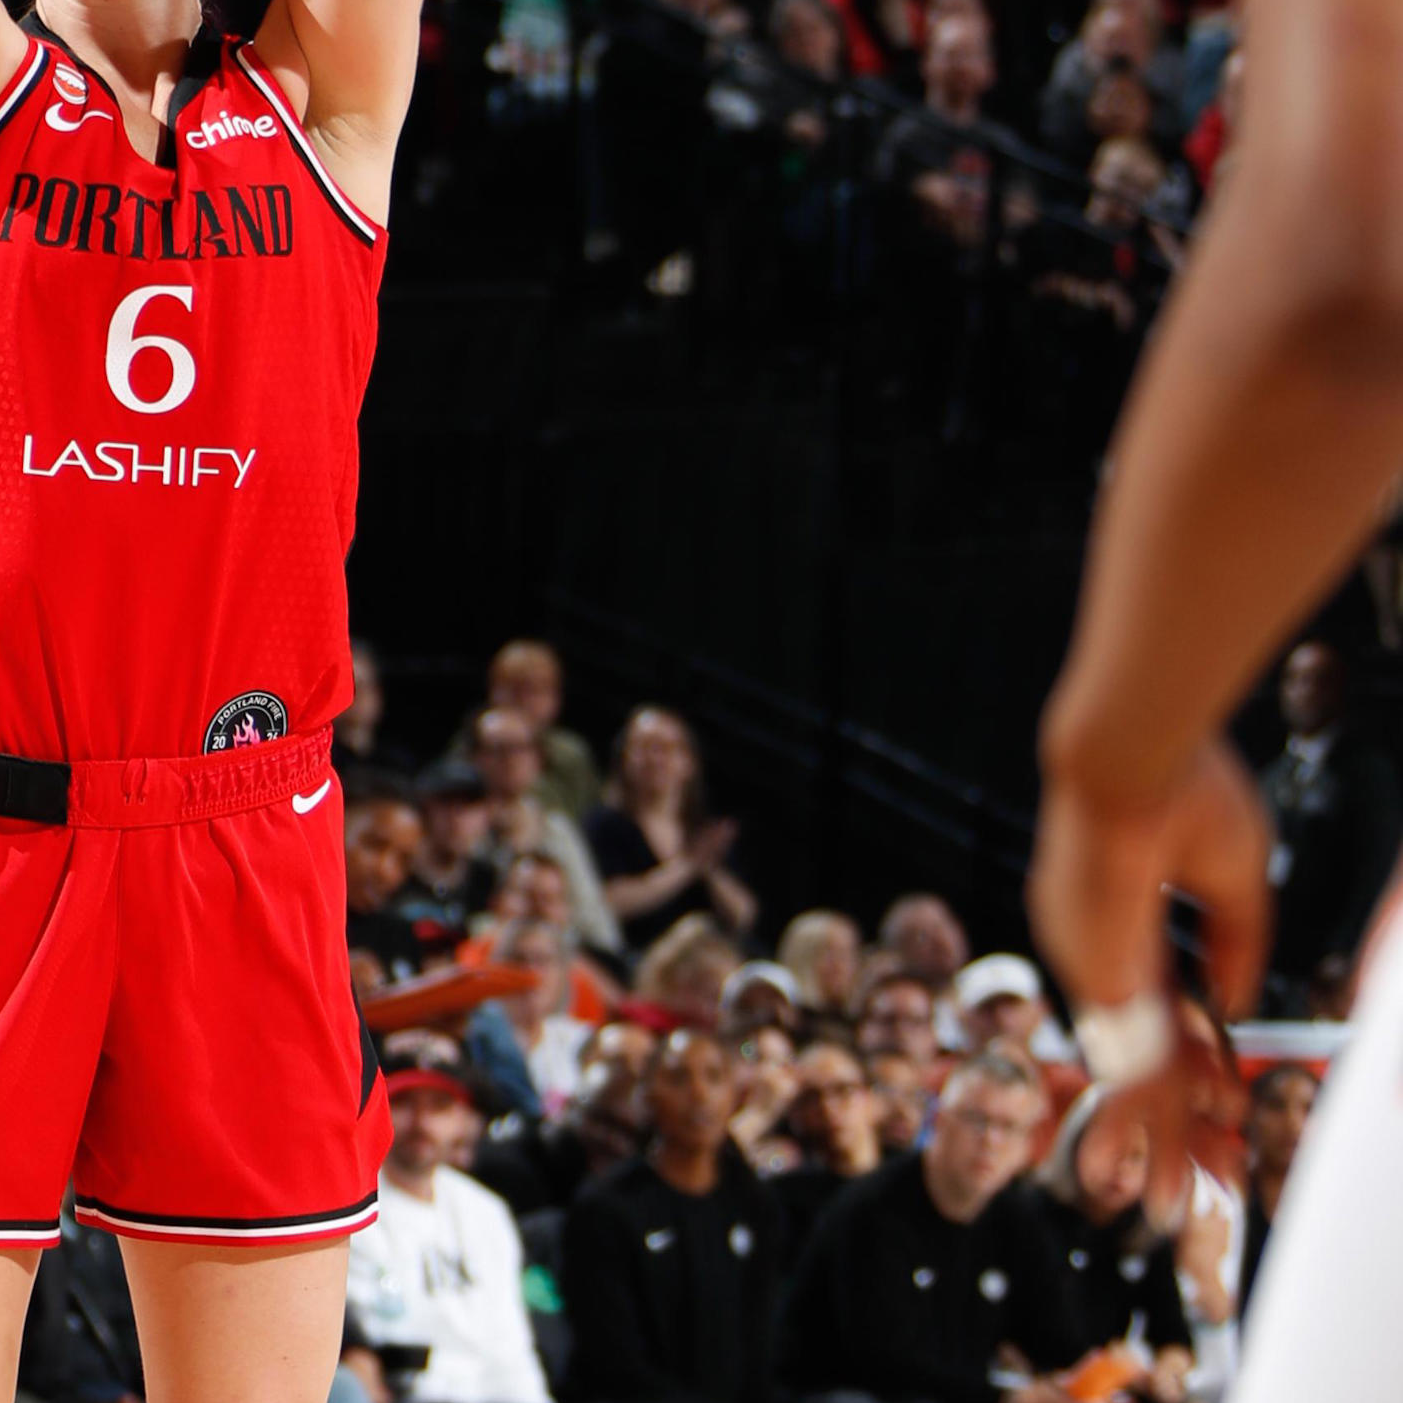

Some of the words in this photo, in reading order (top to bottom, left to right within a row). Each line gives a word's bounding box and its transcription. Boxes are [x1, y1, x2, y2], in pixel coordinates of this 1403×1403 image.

[186, 111, 278, 150] chime
[105, 284, 197, 414] 6
[22, 434, 257, 489] LASHIFY
[217, 696, 268, 725] PORTLAND
[266, 701, 283, 721] FIRE
[212, 735, 227, 749] 20
